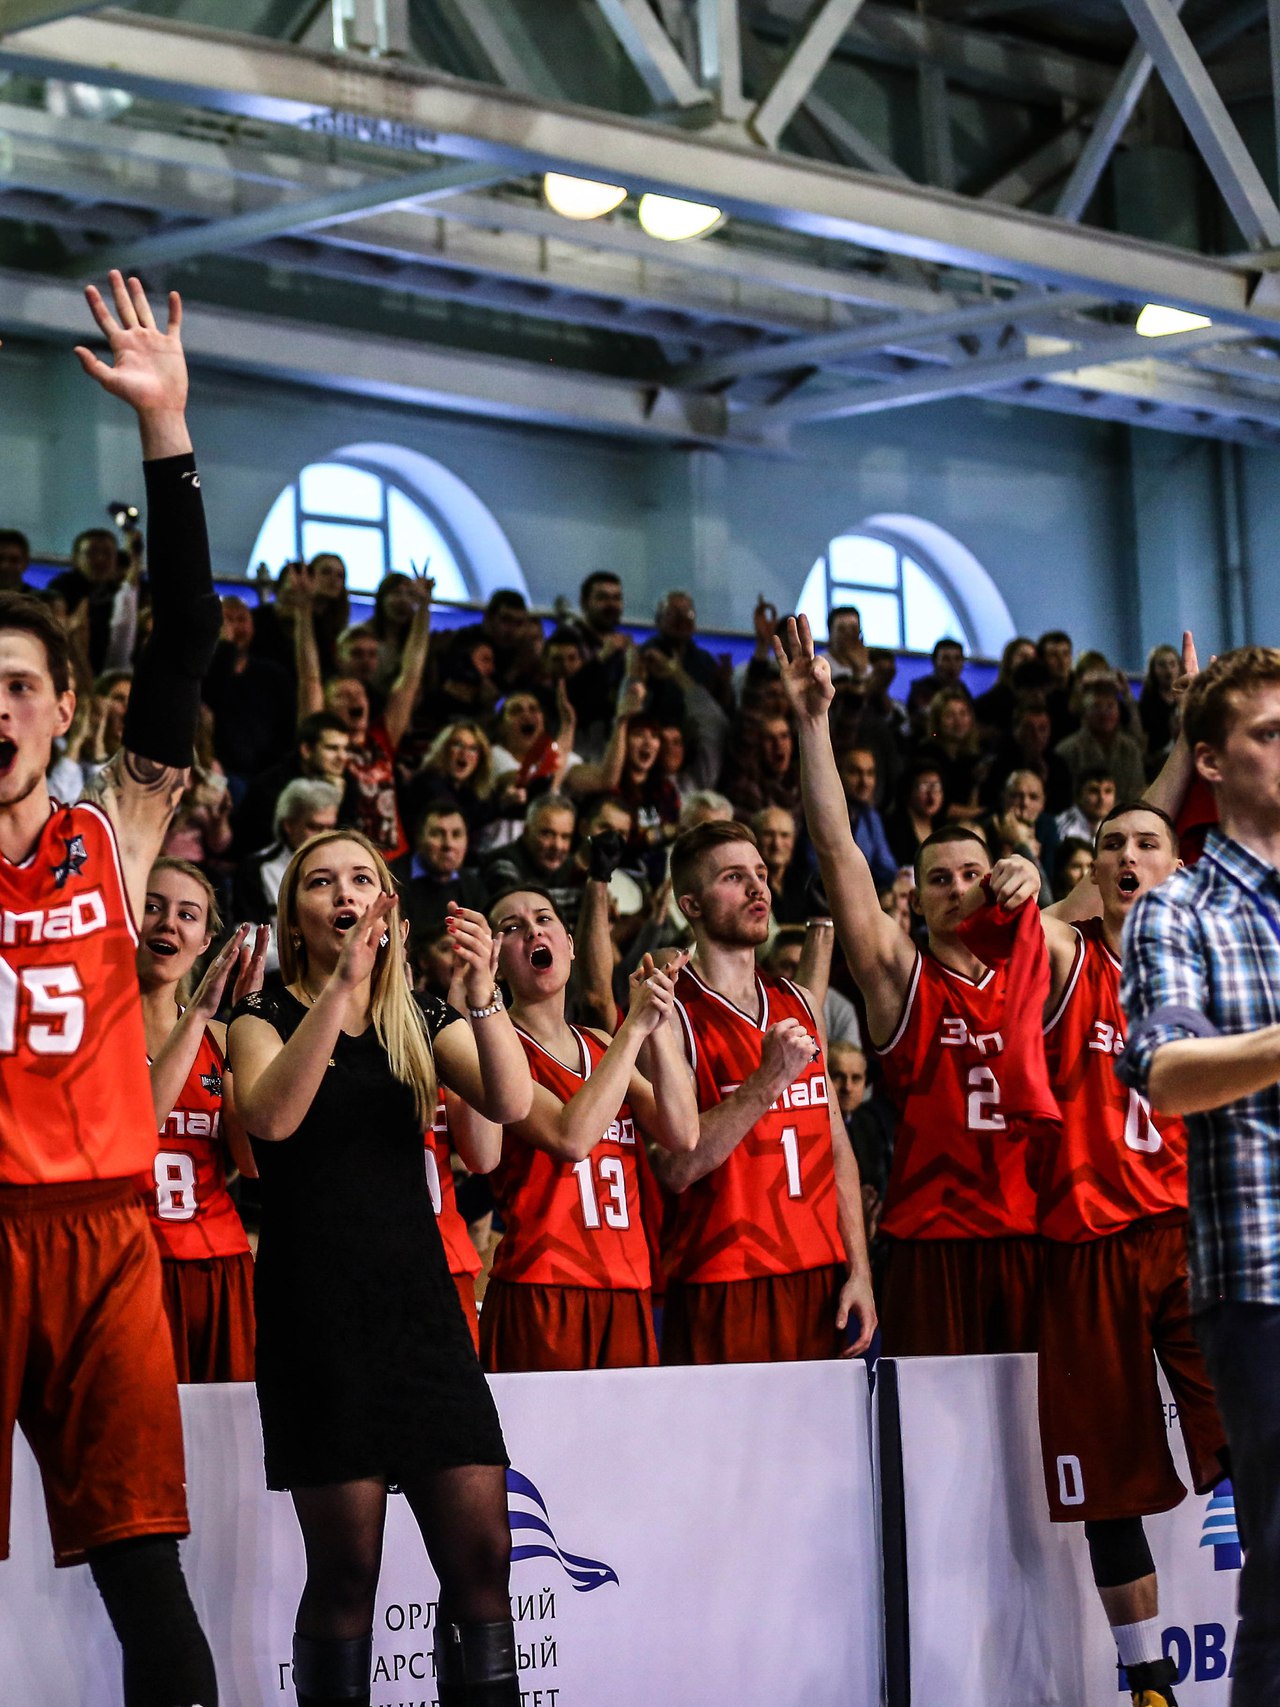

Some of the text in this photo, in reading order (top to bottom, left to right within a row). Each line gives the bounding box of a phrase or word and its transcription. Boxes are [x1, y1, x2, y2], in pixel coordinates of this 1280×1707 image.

[967, 1066, 1007, 1130] 2
[155, 1151, 197, 1221] 8
[572, 1156, 630, 1229] 13
[779, 1127, 803, 1197] 1
[1056, 1455, 1085, 1506] 0
